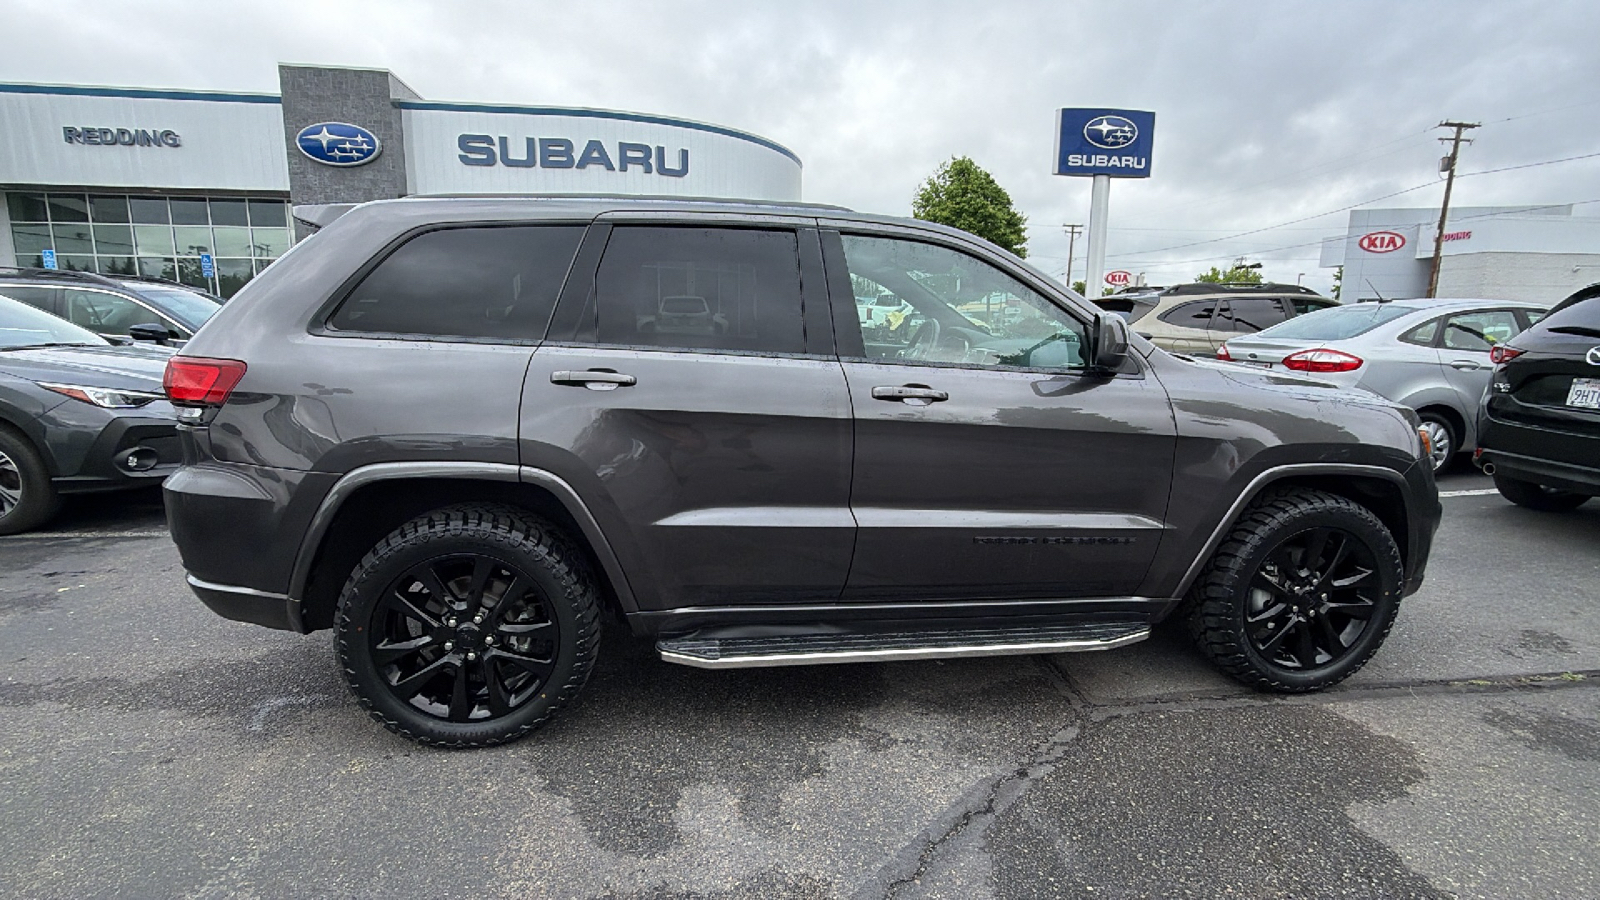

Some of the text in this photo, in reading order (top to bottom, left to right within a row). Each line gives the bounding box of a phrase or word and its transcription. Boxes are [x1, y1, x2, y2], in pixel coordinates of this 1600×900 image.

[62, 126, 181, 147] REDDING
[458, 133, 689, 177] SUBARU
[1068, 154, 1145, 169] SUBARU
[1367, 236, 1397, 248] KIA
[1111, 274, 1129, 282] KIA
